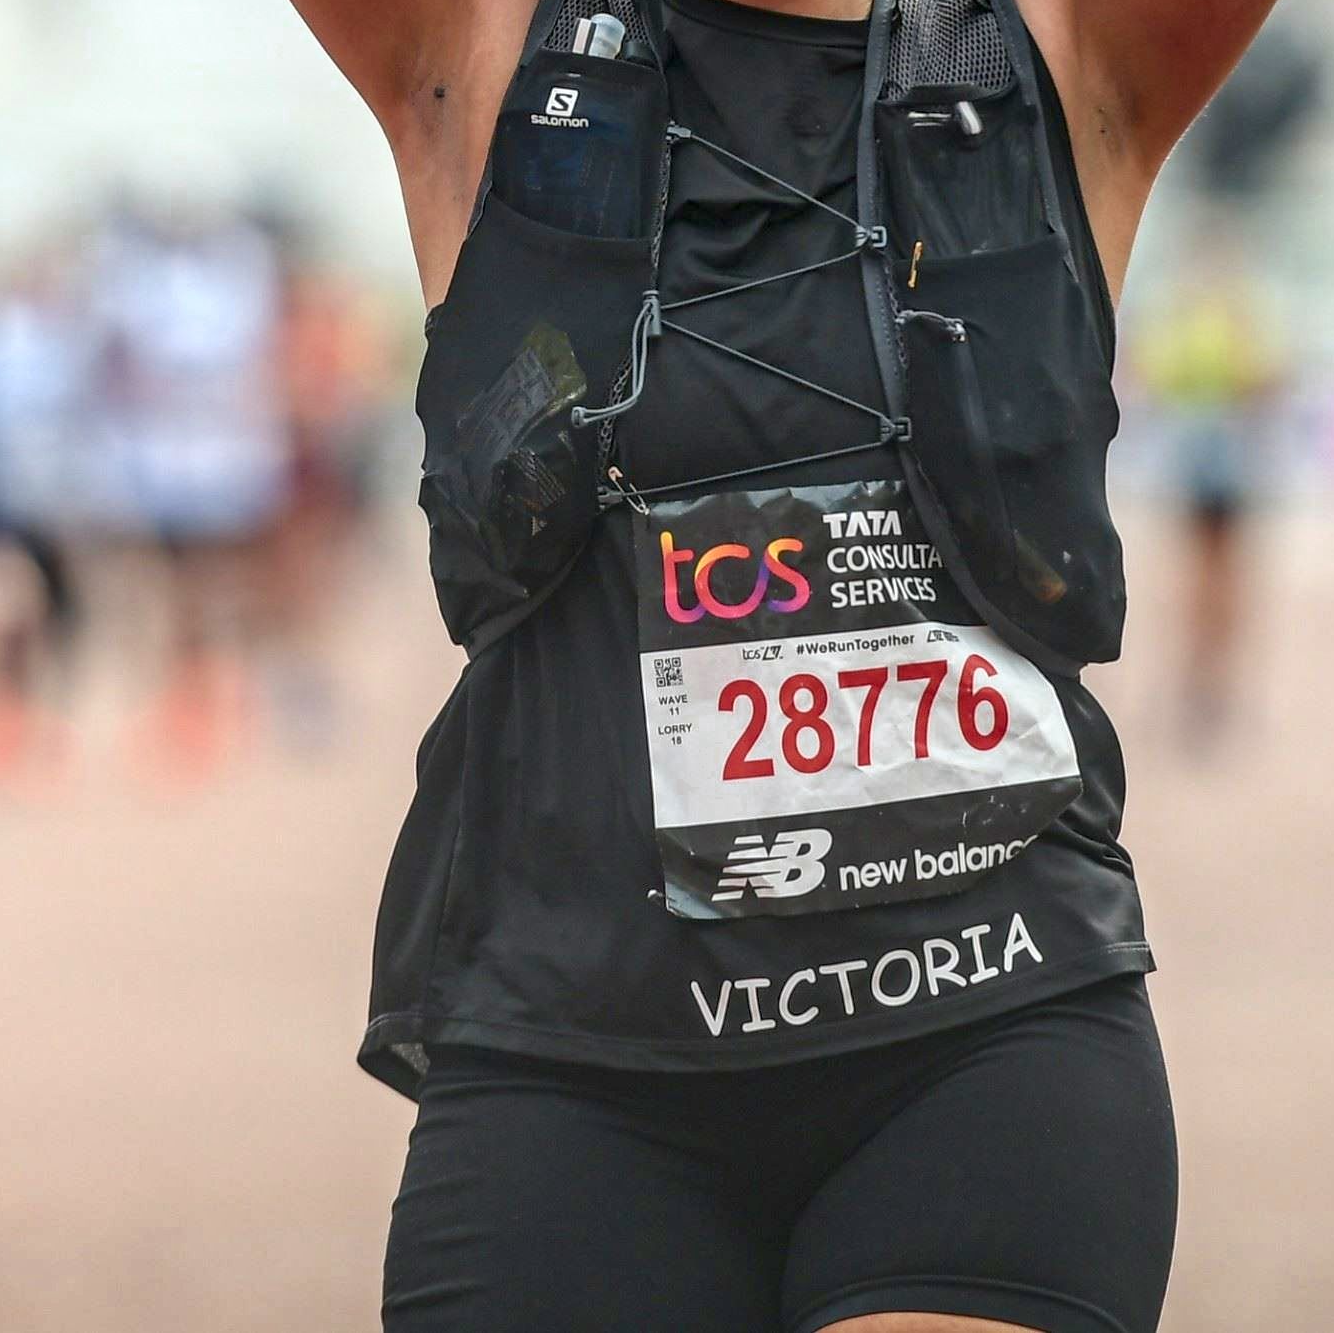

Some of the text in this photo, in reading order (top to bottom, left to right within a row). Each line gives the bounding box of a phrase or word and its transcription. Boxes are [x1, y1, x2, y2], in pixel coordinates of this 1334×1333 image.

[550, 93, 573, 112] S
[822, 510, 902, 539] TATA
[827, 543, 943, 573] CONSULTA
[661, 531, 813, 623] tcs
[830, 576, 936, 608] SERVICES
[796, 634, 914, 655] #WeRunTogether
[658, 694, 688, 705] WAVE
[669, 707, 680, 716] 11
[658, 723, 692, 735] LORRY
[717, 654, 1010, 782] 28776
[839, 834, 1038, 891] new balanc
[690, 912, 1043, 1037] VICTORIA
